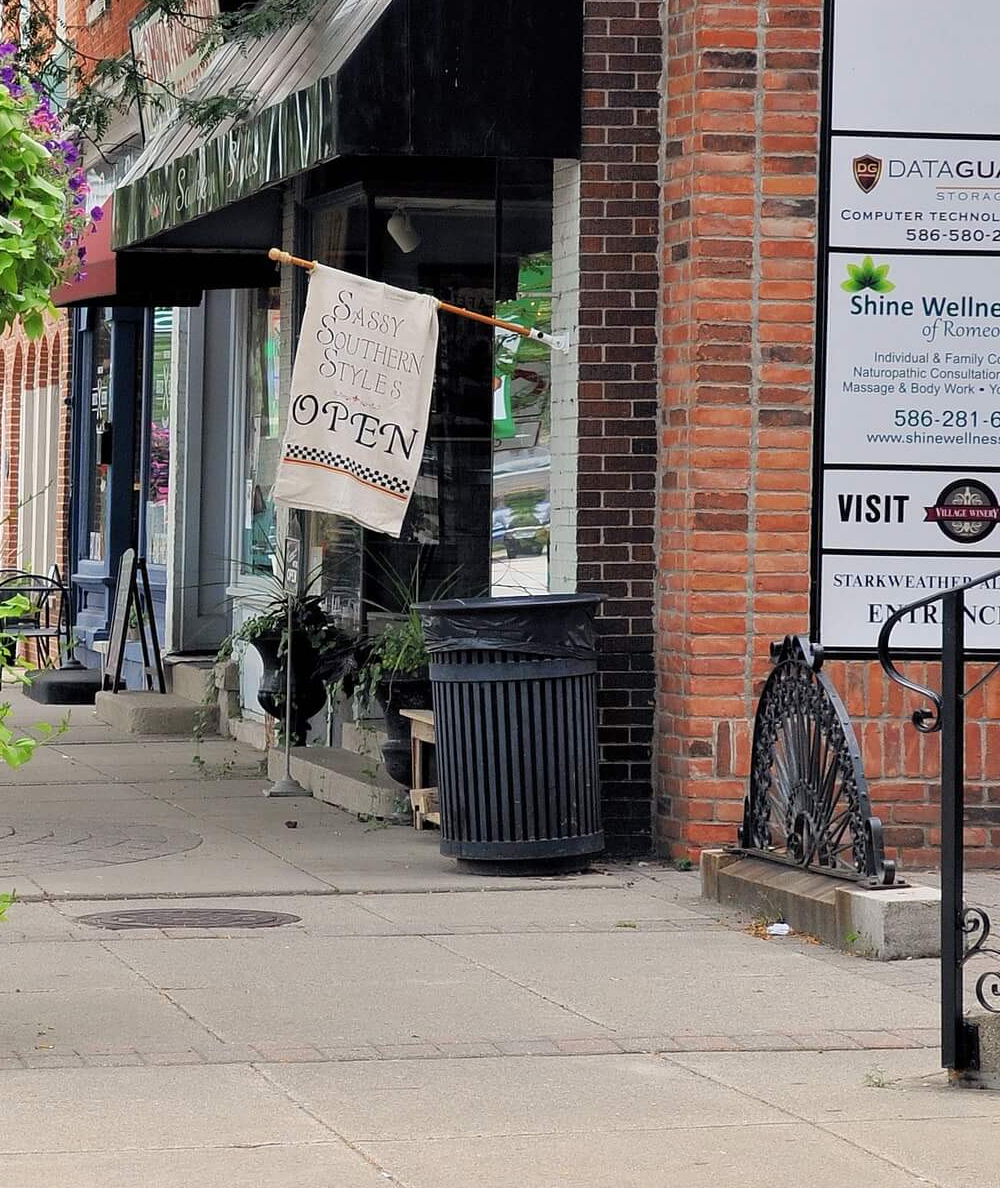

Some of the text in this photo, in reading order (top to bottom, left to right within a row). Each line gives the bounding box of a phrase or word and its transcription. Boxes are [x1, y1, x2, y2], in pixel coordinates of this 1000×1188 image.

[857, 163, 878, 173] DG
[841, 210, 1000, 222] COMPUTER TECHNOL
[906, 229, 1000, 242] 586-580-2
[850, 295, 1000, 317] Shine Wellne
[922, 318, 1000, 342] of Romeo
[874, 352, 929, 363] Individual
[933, 353, 941, 363] &
[945, 353, 984, 367] Family
[853, 367, 927, 380] Naturopathic
[842, 382, 895, 396] Massage
[899, 383, 907, 393] &
[911, 383, 941, 396] Body
[944, 384, 975, 394] Work
[895, 410, 1000, 428] 586-281-6
[292, 394, 418, 461] OPEN
[838, 494, 910, 523] VISIT
[936, 507, 997, 519] VILLAGE WINERY
